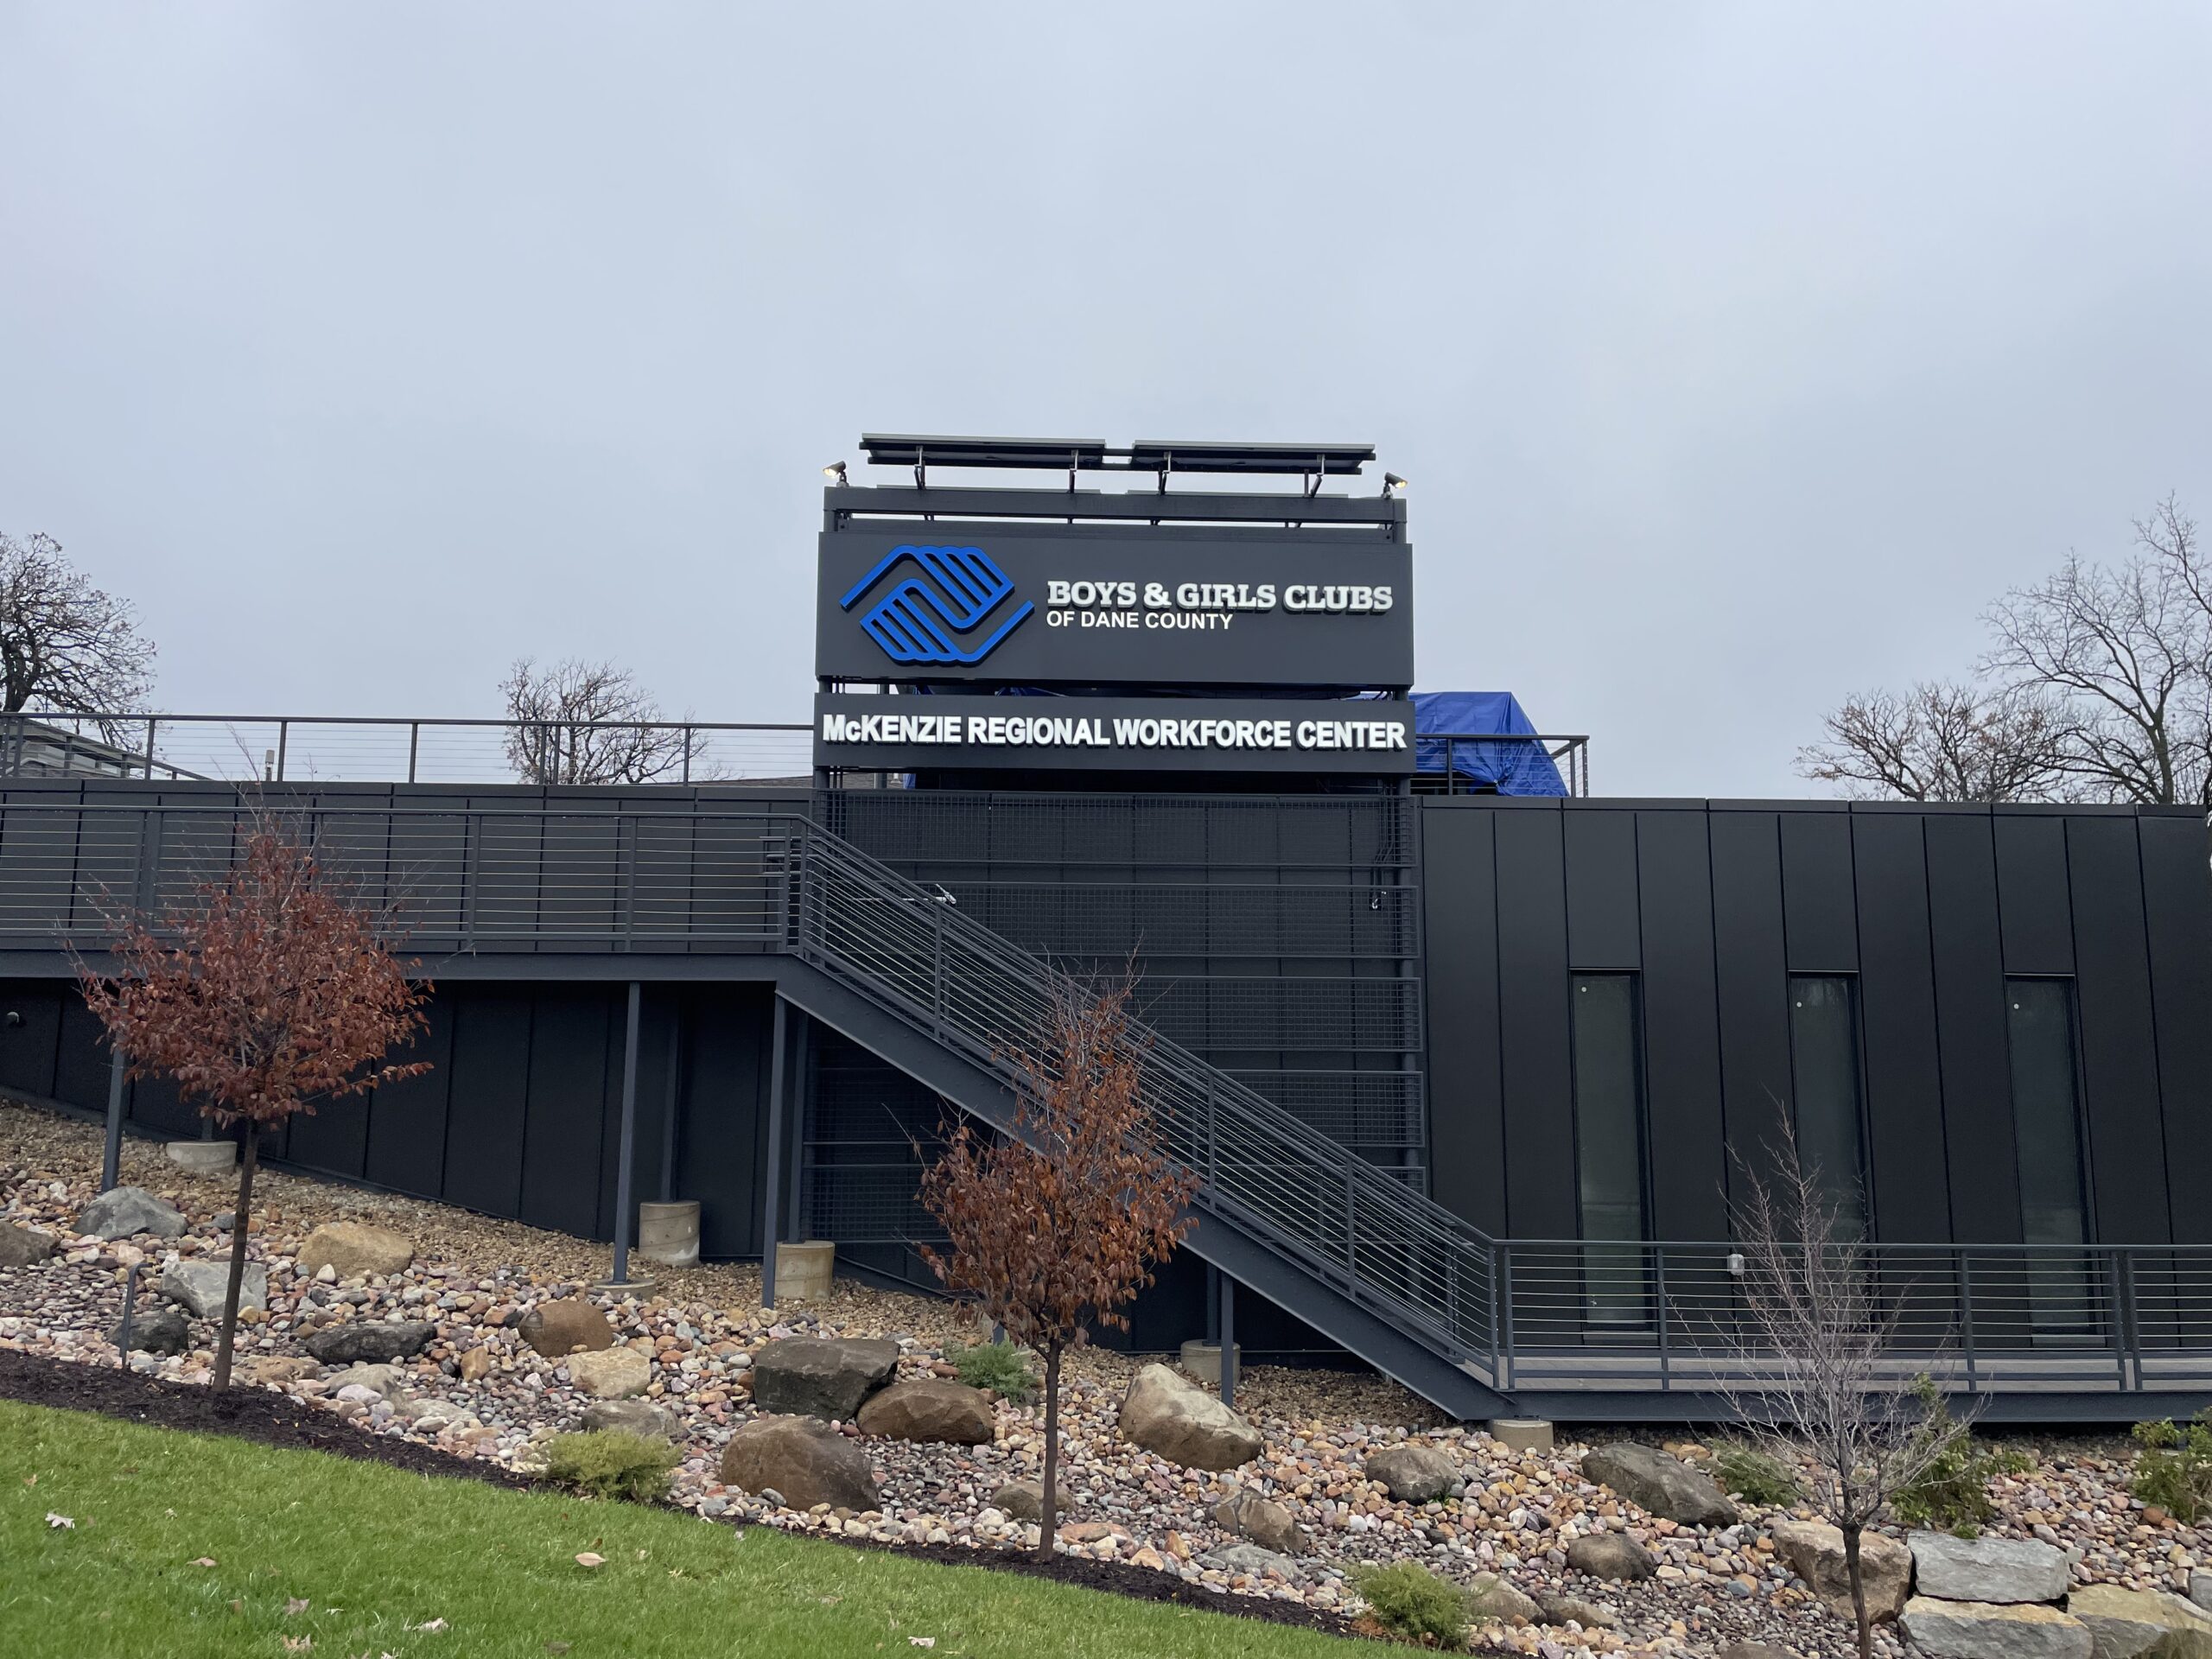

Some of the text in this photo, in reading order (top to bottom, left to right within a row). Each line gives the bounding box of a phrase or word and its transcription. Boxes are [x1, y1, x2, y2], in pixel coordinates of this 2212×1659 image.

[1047, 581, 1394, 611] BOYS & GIRLS CLUBS
[1046, 610, 1234, 630] OF DANE COUNTY
[822, 714, 1408, 749] McKENZIE REGIONAL WORKFORCE CENTER
